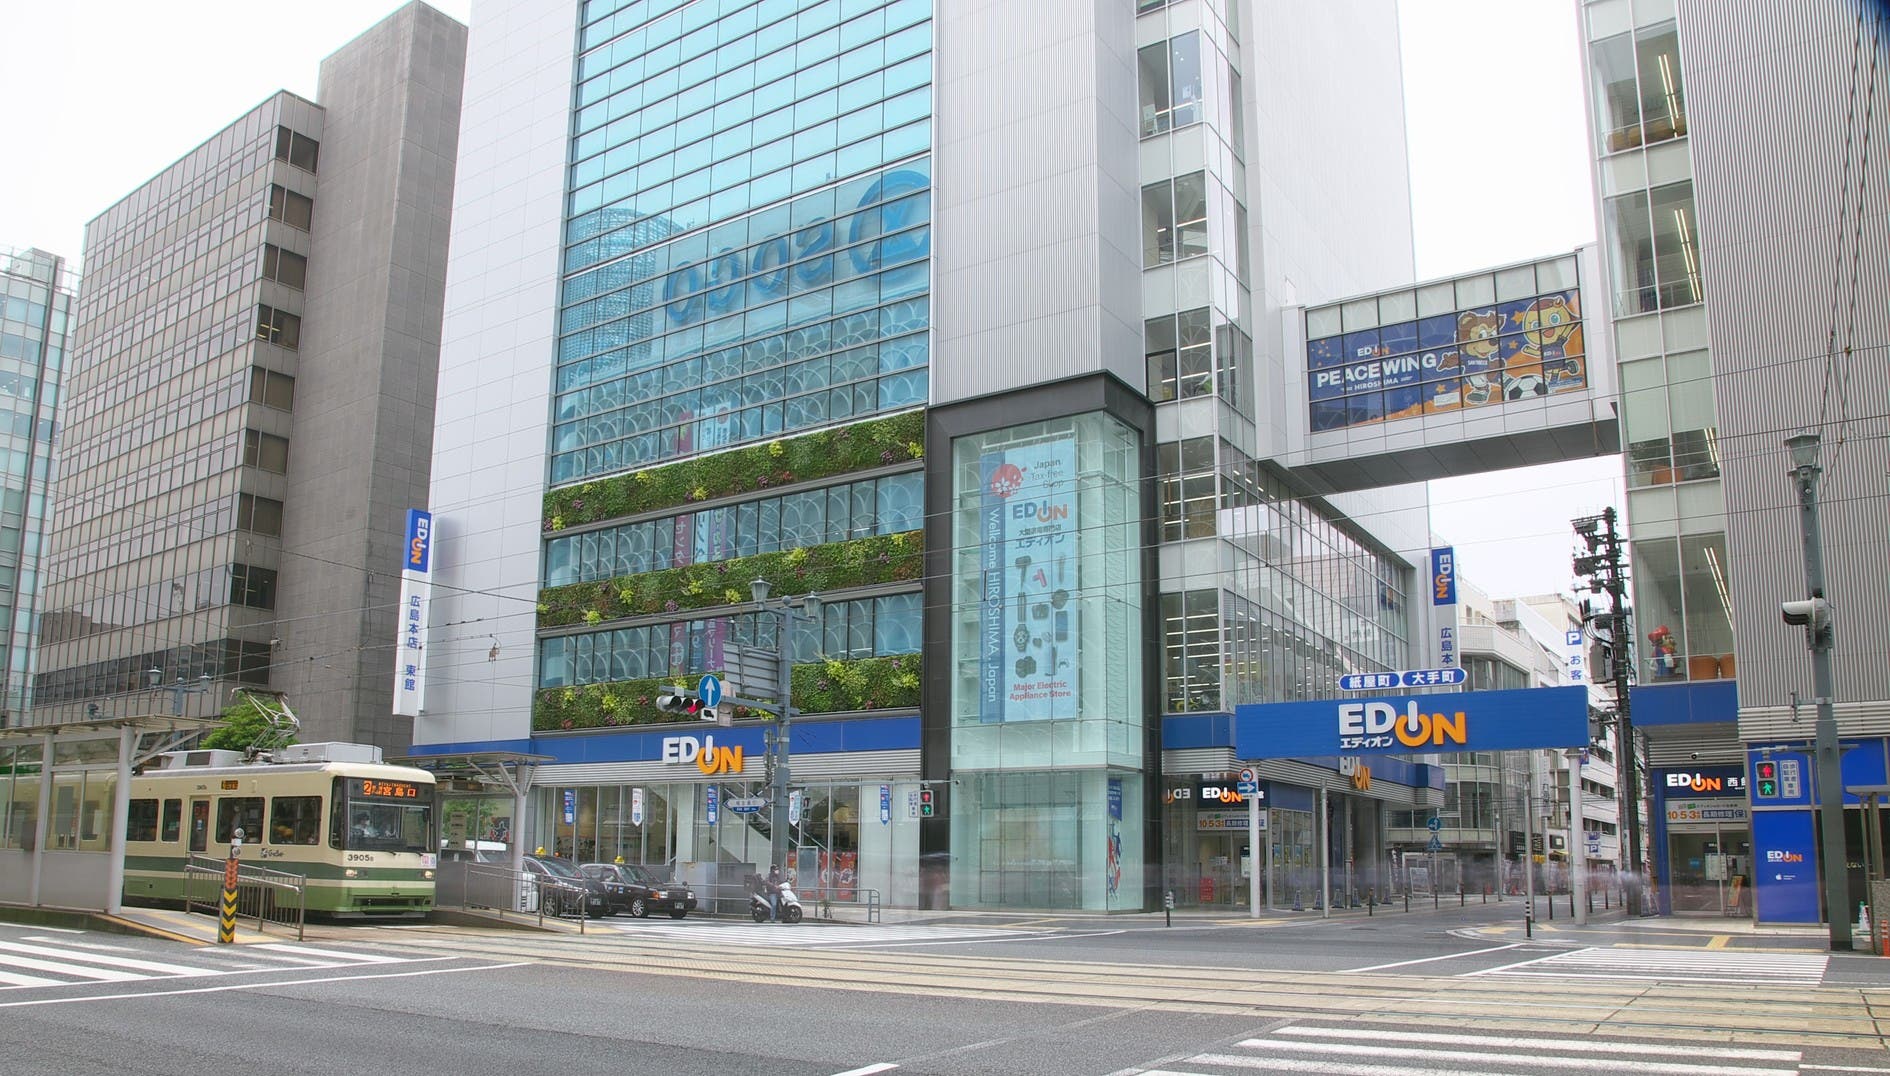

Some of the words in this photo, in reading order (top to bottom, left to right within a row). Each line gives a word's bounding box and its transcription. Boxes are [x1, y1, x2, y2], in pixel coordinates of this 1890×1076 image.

[1034, 459, 1061, 469] Japan
[1013, 500, 1068, 522] EDION
[411, 517, 429, 564] EDION
[988, 507, 1000, 569] Wellcome
[1435, 554, 1452, 598] EDION
[407, 595, 422, 650] 広島本店
[1441, 627, 1453, 668] 広島本
[404, 664, 416, 692] 東館
[985, 663, 999, 702] Japan
[1013, 682, 1035, 692] Major
[1349, 675, 1390, 688] 紙屋町
[1412, 670, 1455, 685] 大手町
[1009, 691, 1048, 702] Appliance
[1338, 700, 1467, 747] EDION
[1340, 736, 1393, 748] エディオン
[662, 735, 743, 775] EDION
[363, 780, 372, 795] 2
[1666, 773, 1722, 791] EDION
[1202, 787, 1242, 803] EDION
[1766, 850, 1804, 862] EDION
